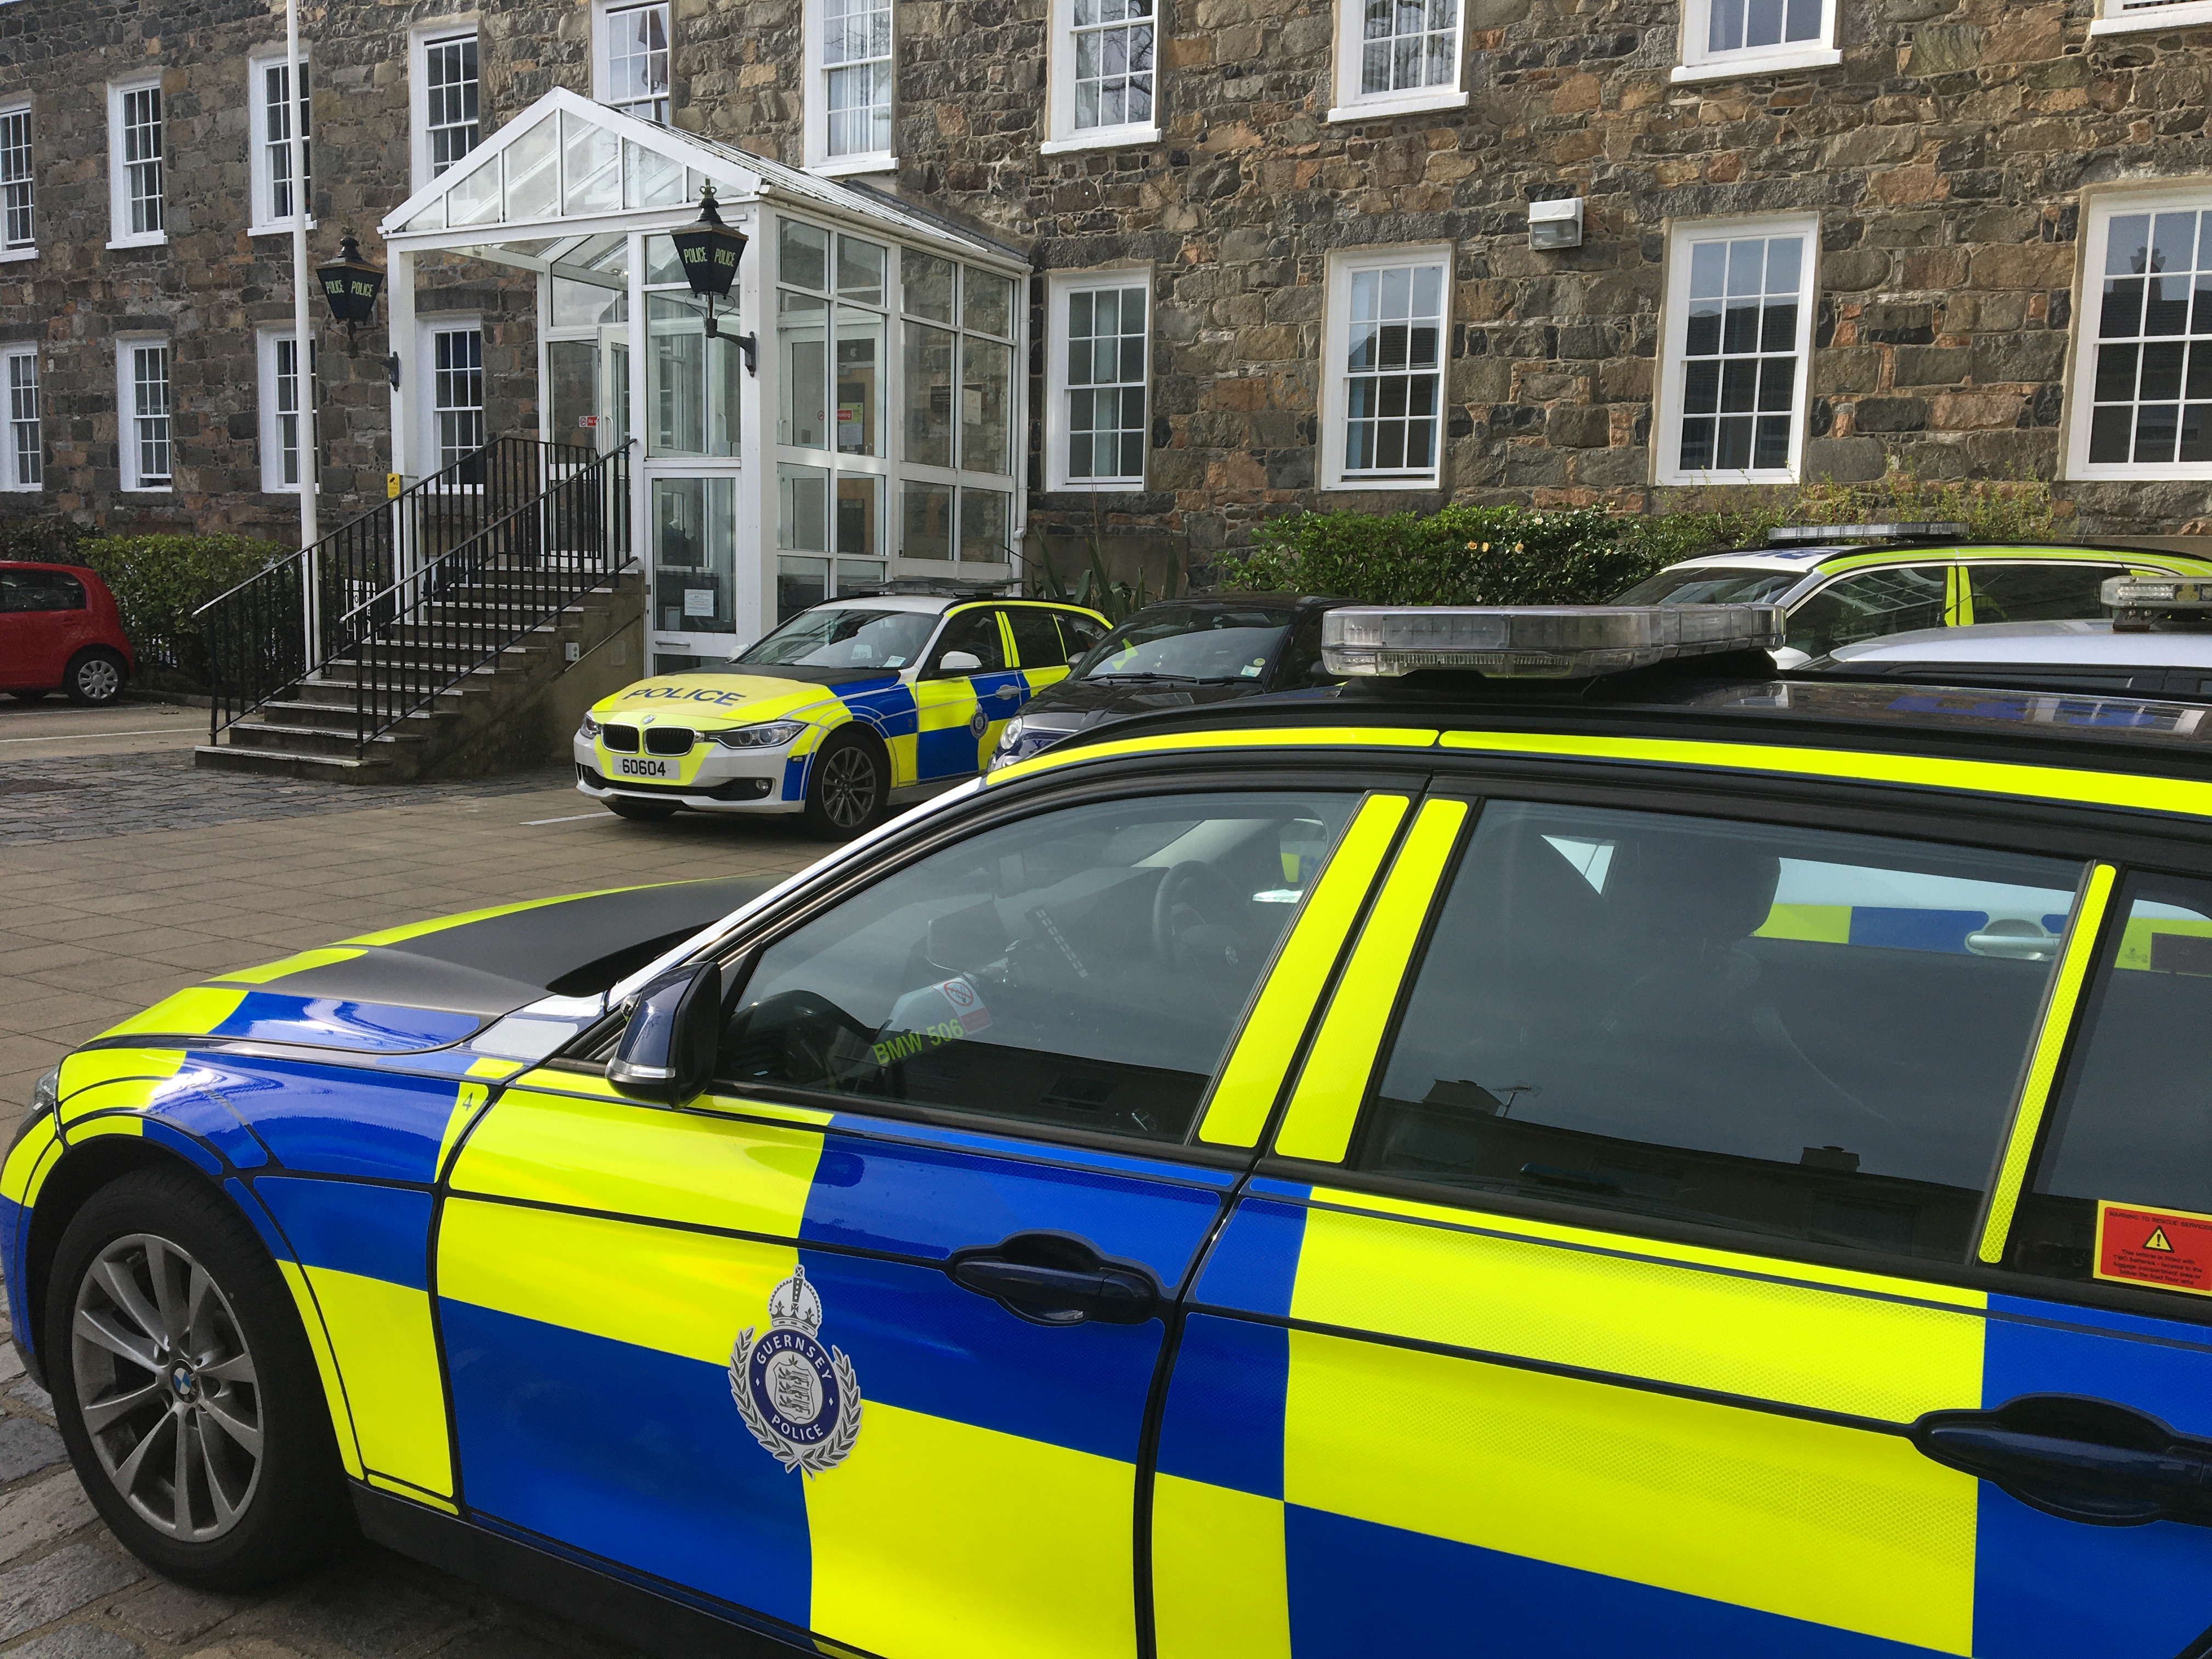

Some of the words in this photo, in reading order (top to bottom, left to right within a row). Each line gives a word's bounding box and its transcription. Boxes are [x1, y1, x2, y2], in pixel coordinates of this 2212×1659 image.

[684, 247, 707, 264] POLICE
[714, 249, 736, 267] POLICE
[325, 280, 345, 294] POLICE
[351, 281, 374, 297] POLICE
[622, 687, 748, 707] POLICE
[622, 758, 666, 777] 60604
[872, 1031, 924, 1065] BMW
[927, 1018, 964, 1046] 506
[462, 1092, 473, 1111] 4
[756, 1334, 832, 1379] GUERNSEY
[771, 1414, 824, 1441] POLICE
